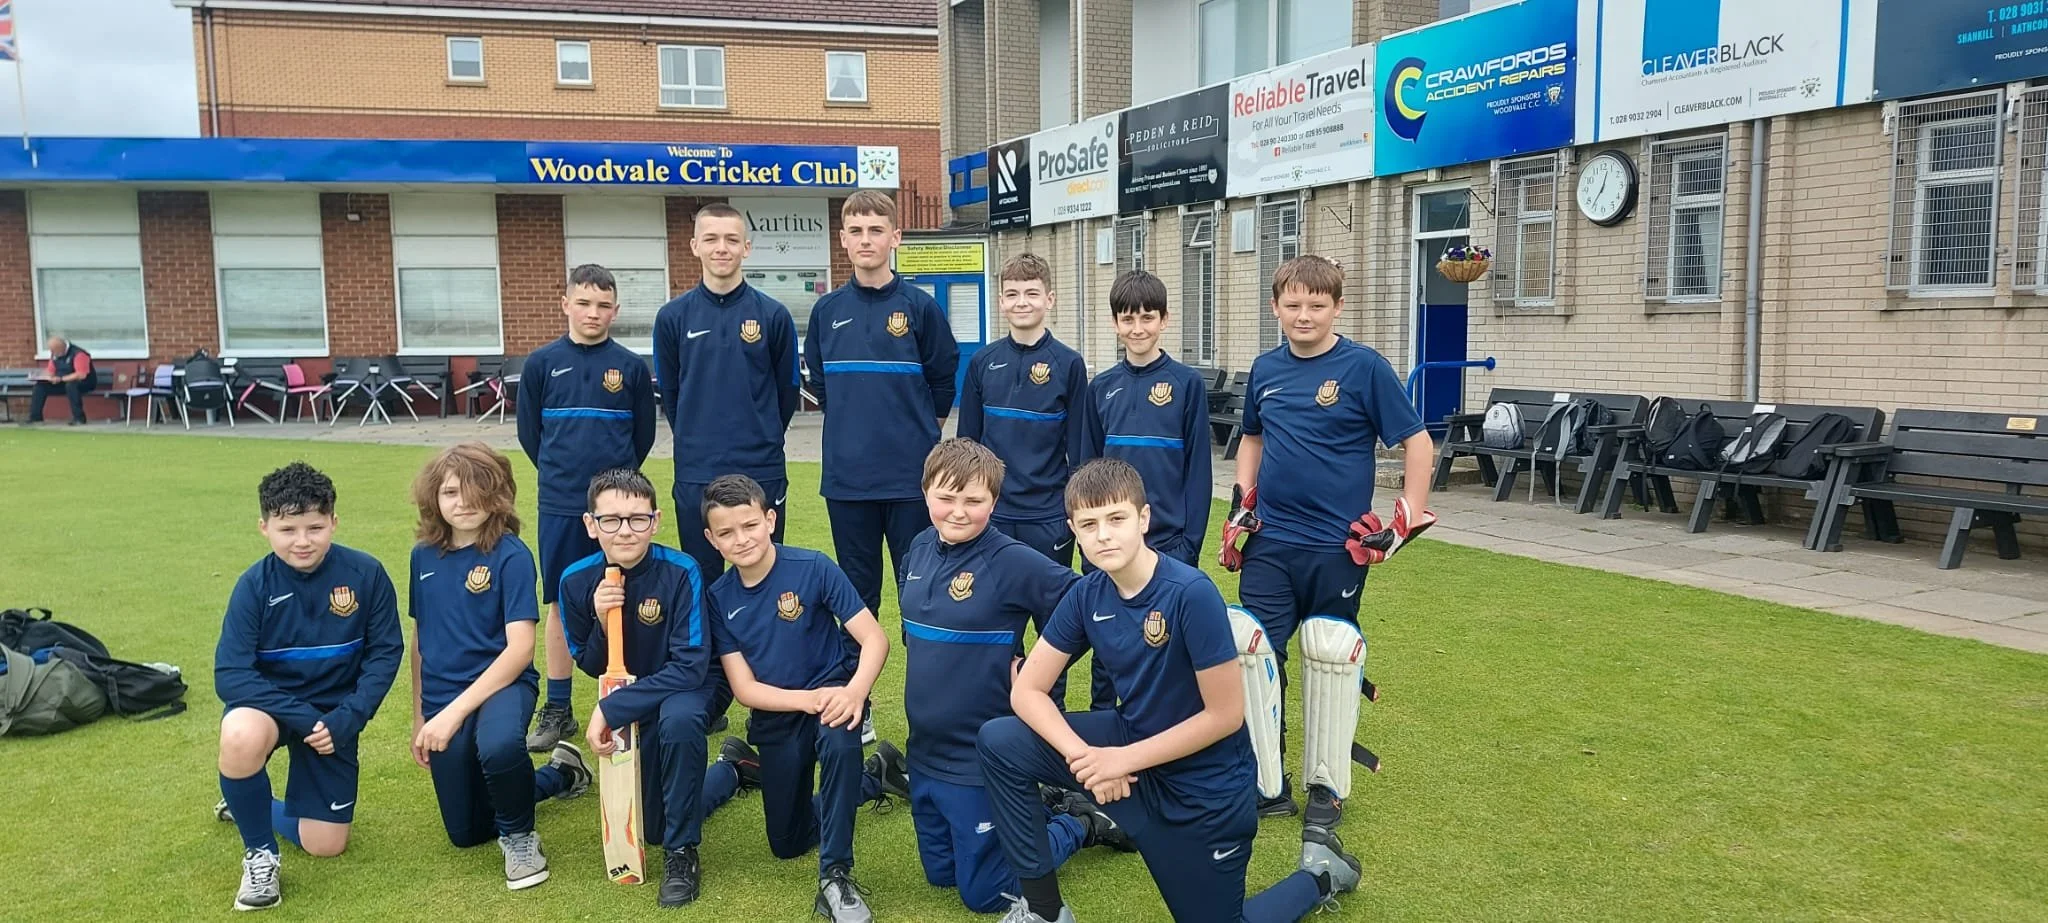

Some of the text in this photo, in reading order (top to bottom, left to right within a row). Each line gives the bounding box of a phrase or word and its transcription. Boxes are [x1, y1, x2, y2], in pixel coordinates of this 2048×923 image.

[1999, 5, 2018, 21] 028
[2020, 0, 2043, 18] 9031
[1957, 28, 1994, 44] SHANKILL
[1995, 51, 2023, 61] PROUDLY
[1426, 42, 1567, 89] CRAWFORDS
[1426, 62, 1566, 102] ACCIDENT REPAIRS
[1487, 91, 1541, 109] PROUDLY SPONSORS
[1493, 103, 1527, 115] WOODVALE
[1674, 96, 1743, 115] CLEAVERBLACK.COM
[1252, 102, 1342, 132] For All Your Travel Needs
[1616, 113, 1627, 124] 028
[1628, 111, 1645, 123] 9032
[1645, 109, 1662, 120] 2904
[1129, 115, 1213, 145] PEDEN & REID
[667, 146, 733, 158] Welcome To
[1147, 137, 1190, 152] SOLICITORS
[1038, 136, 1109, 181] ProSafe
[529, 157, 857, 185] Woodvale Cricket Club
[609, 863, 630, 878] SM
